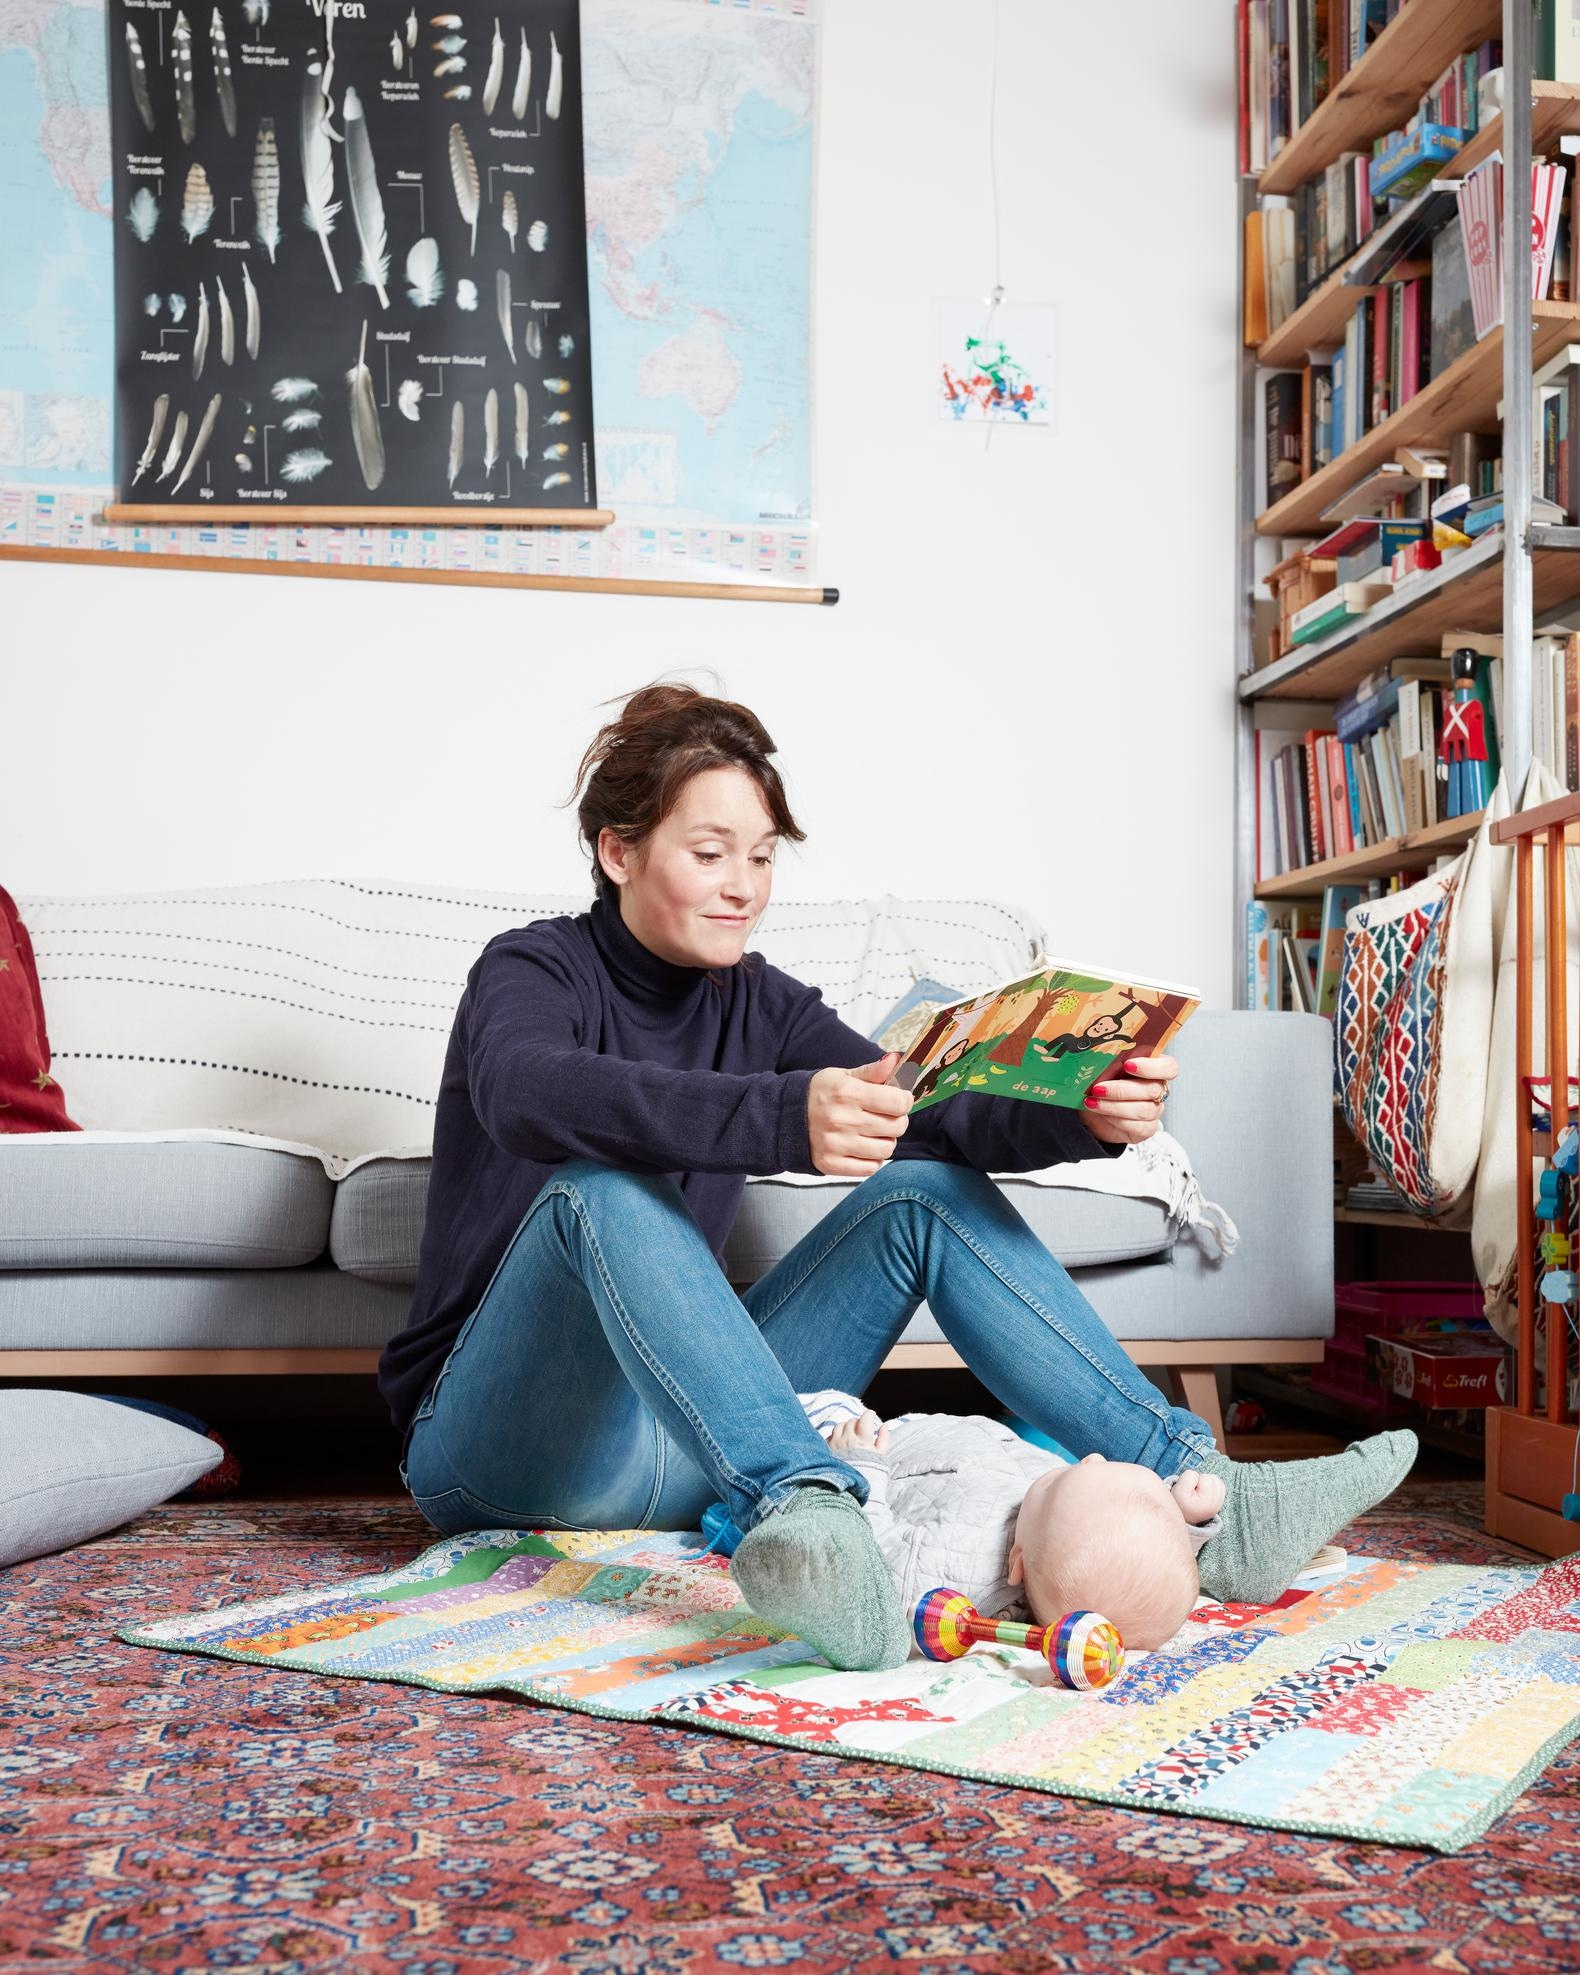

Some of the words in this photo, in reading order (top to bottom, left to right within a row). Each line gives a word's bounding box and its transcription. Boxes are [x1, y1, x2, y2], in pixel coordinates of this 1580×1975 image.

[306, 0, 367, 19] Vren
[1012, 1080, 1029, 1092] de
[1032, 1085, 1057, 1099] aap
[1459, 1374, 1489, 1389] Trefl
